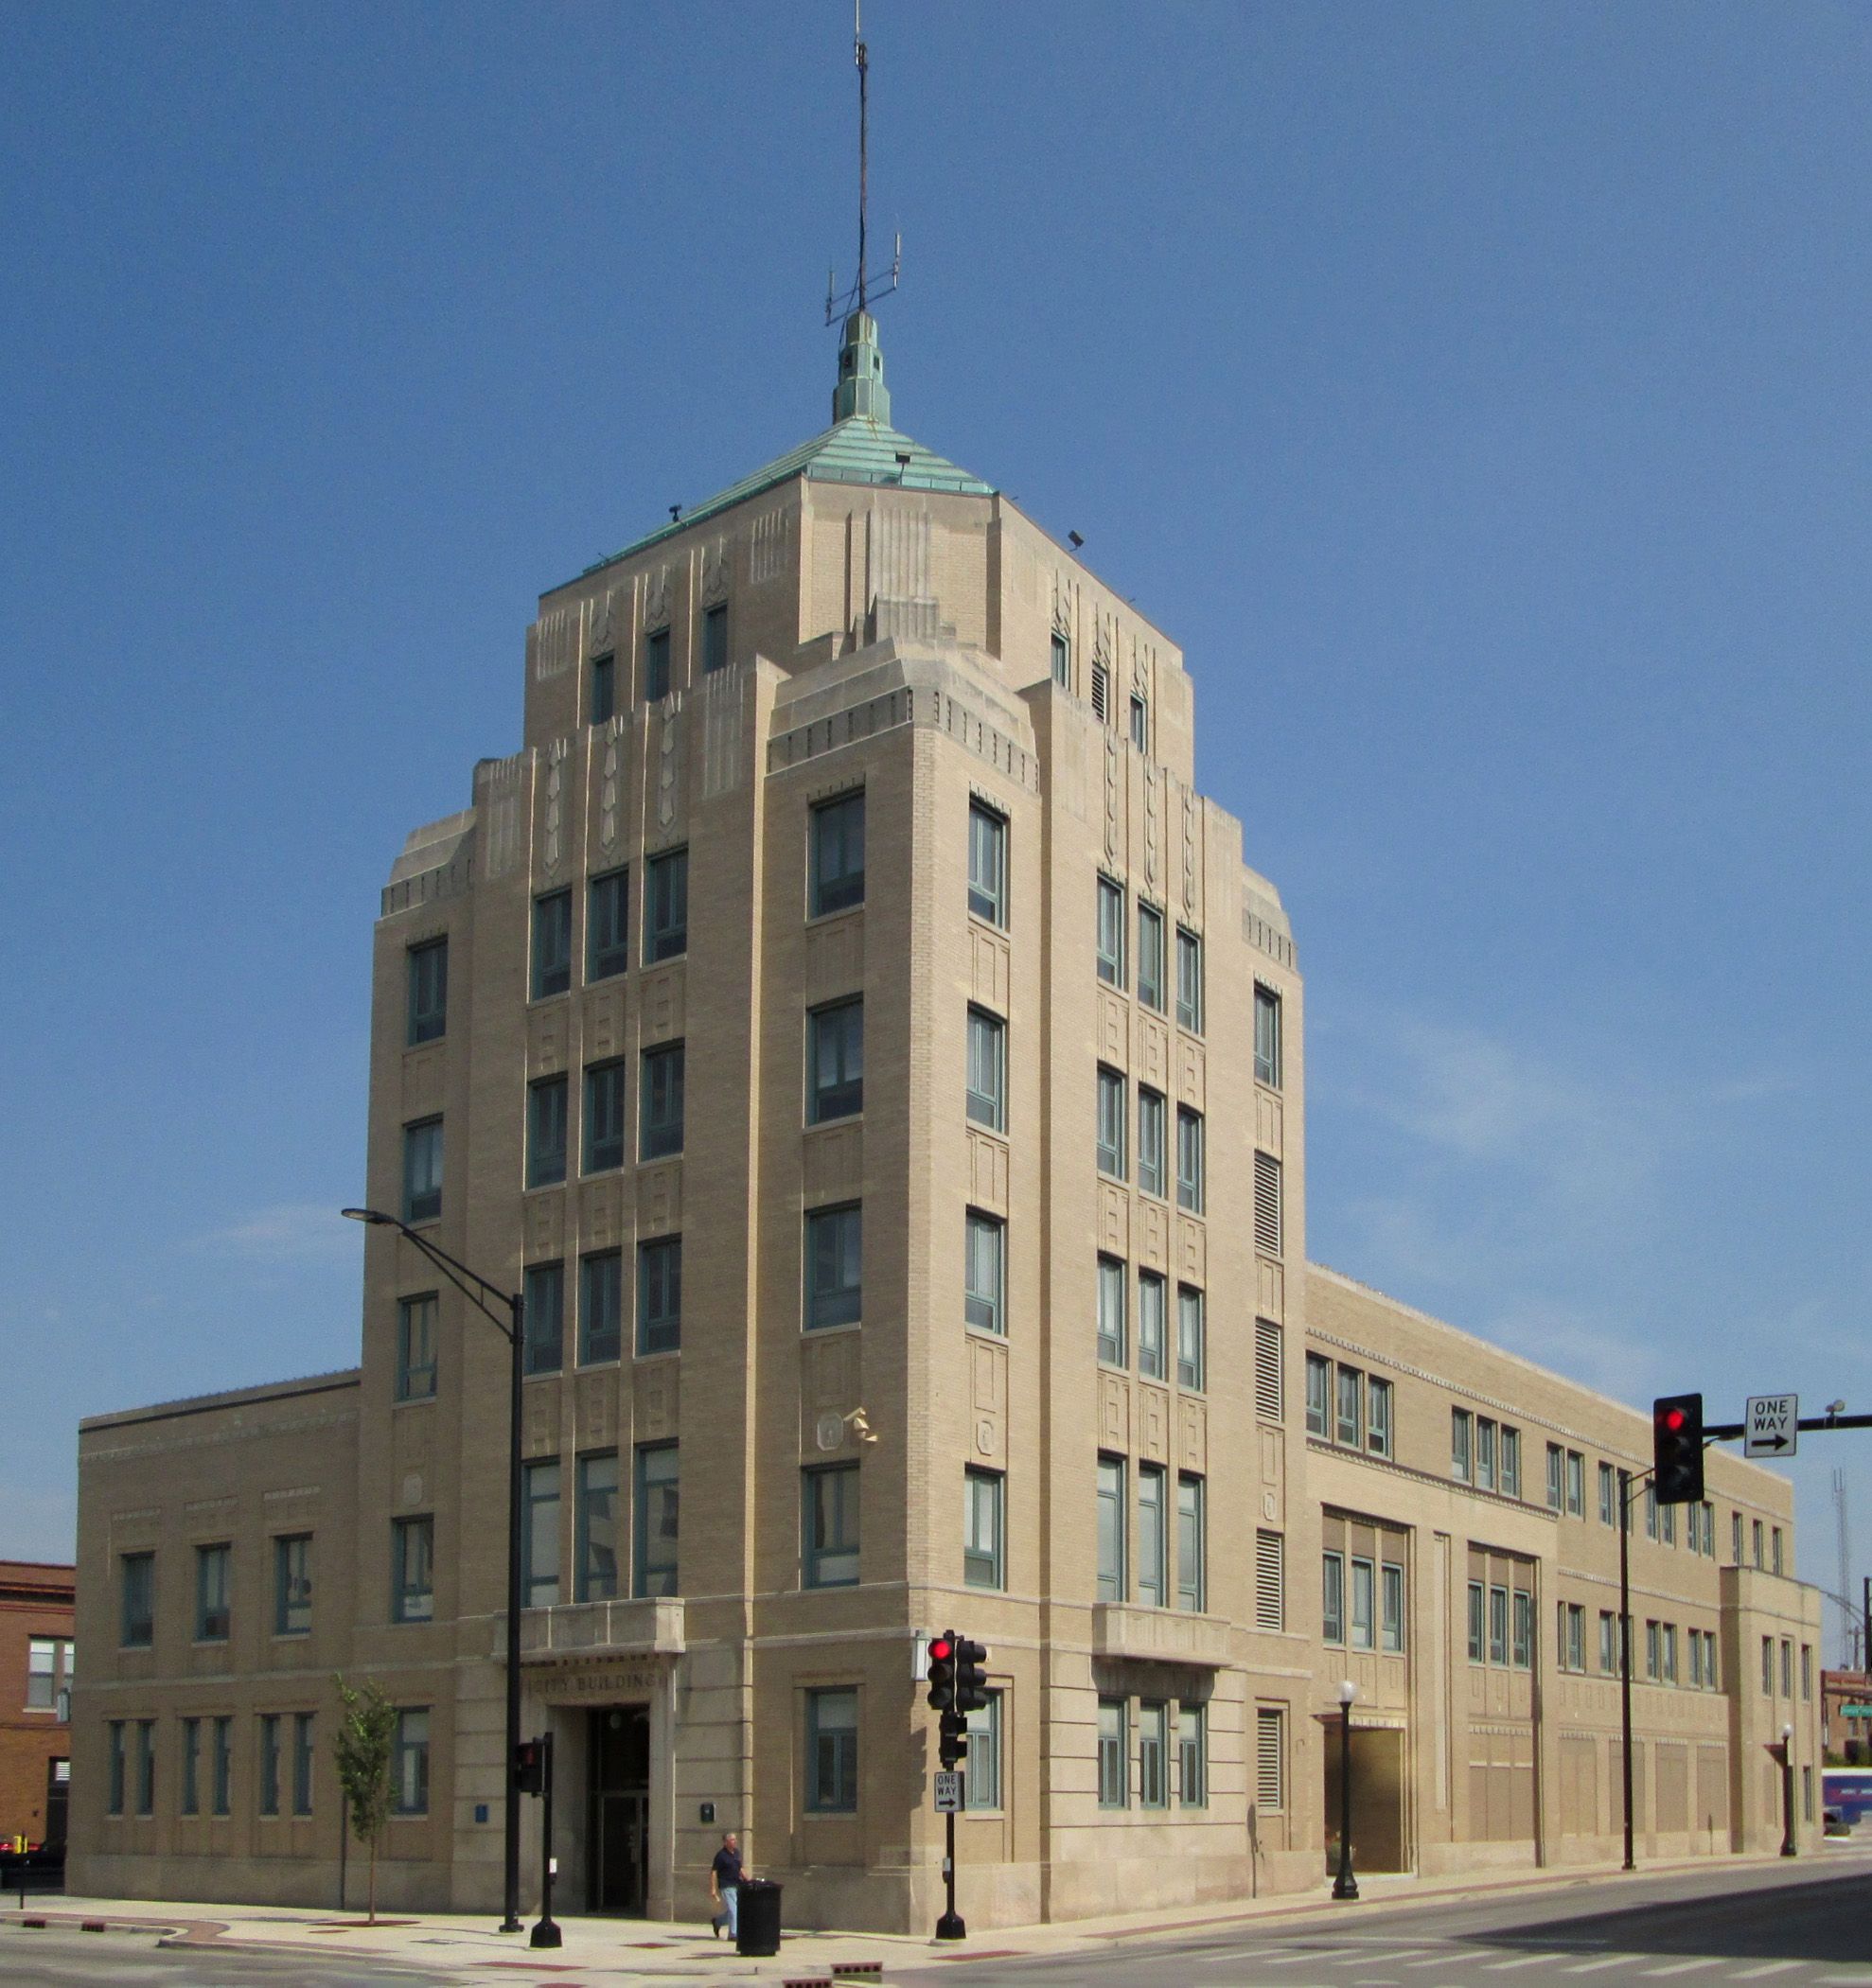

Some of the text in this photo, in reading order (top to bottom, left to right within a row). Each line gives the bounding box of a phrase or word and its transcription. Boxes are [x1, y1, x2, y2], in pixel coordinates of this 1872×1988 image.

[1756, 1400, 1788, 1415] ONE
[1755, 1416, 1787, 1431] WAY
[577, 1673, 655, 1691] BUILDING
[938, 1775, 956, 1785] ONE
[938, 1786, 956, 1795] WAY
